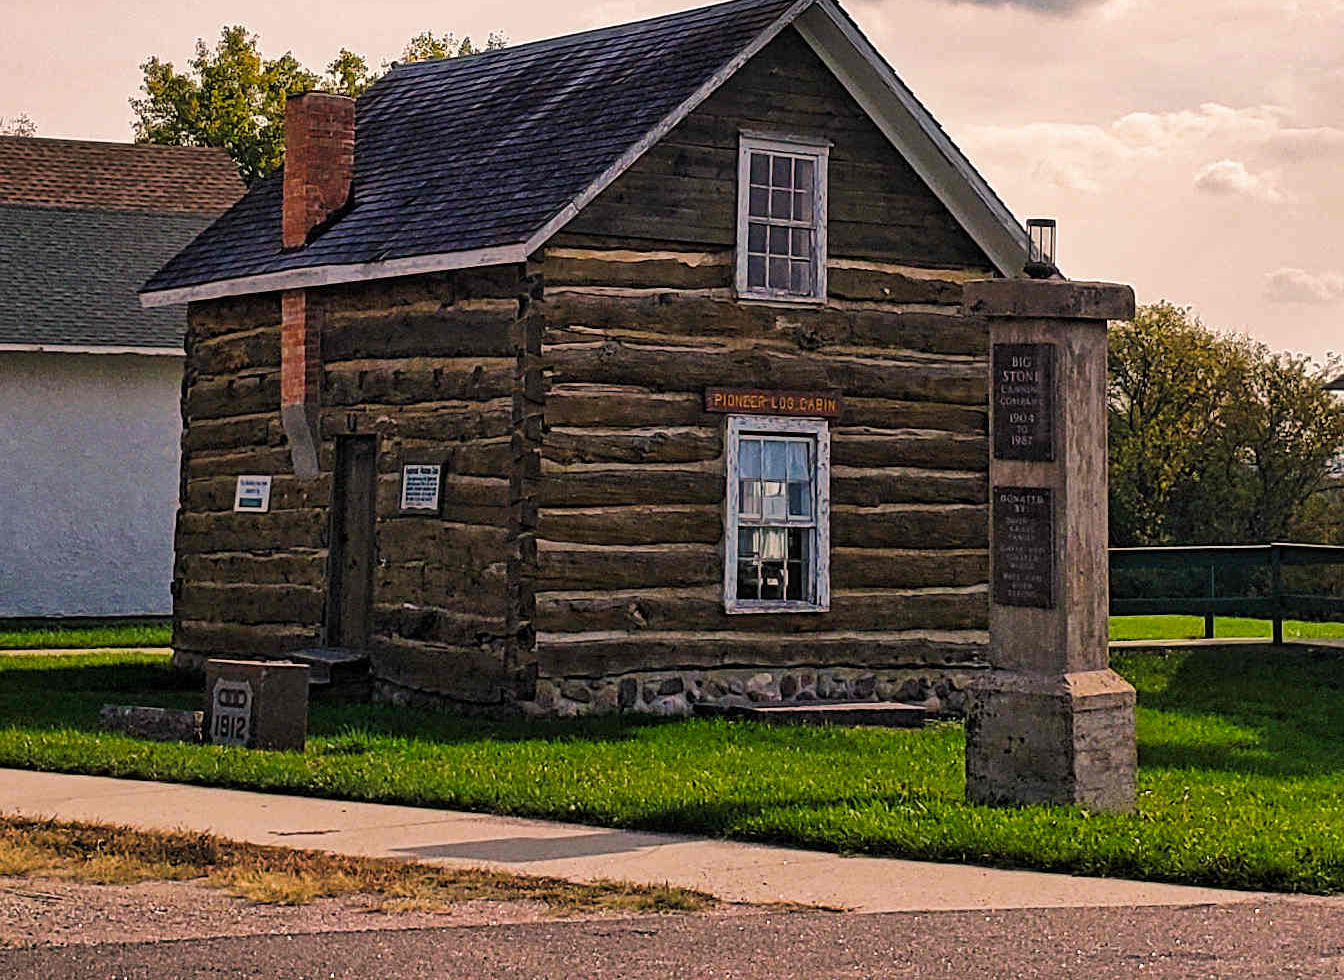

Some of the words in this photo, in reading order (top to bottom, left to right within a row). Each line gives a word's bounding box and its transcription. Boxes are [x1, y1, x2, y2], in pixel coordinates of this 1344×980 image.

[1012, 355, 1032, 368] BIG
[712, 393, 768, 409] PIONEER
[772, 395, 794, 411] LOG
[799, 397, 836, 413] CABIN
[1009, 412, 1035, 423] 1904
[215, 715, 247, 740] 1912
